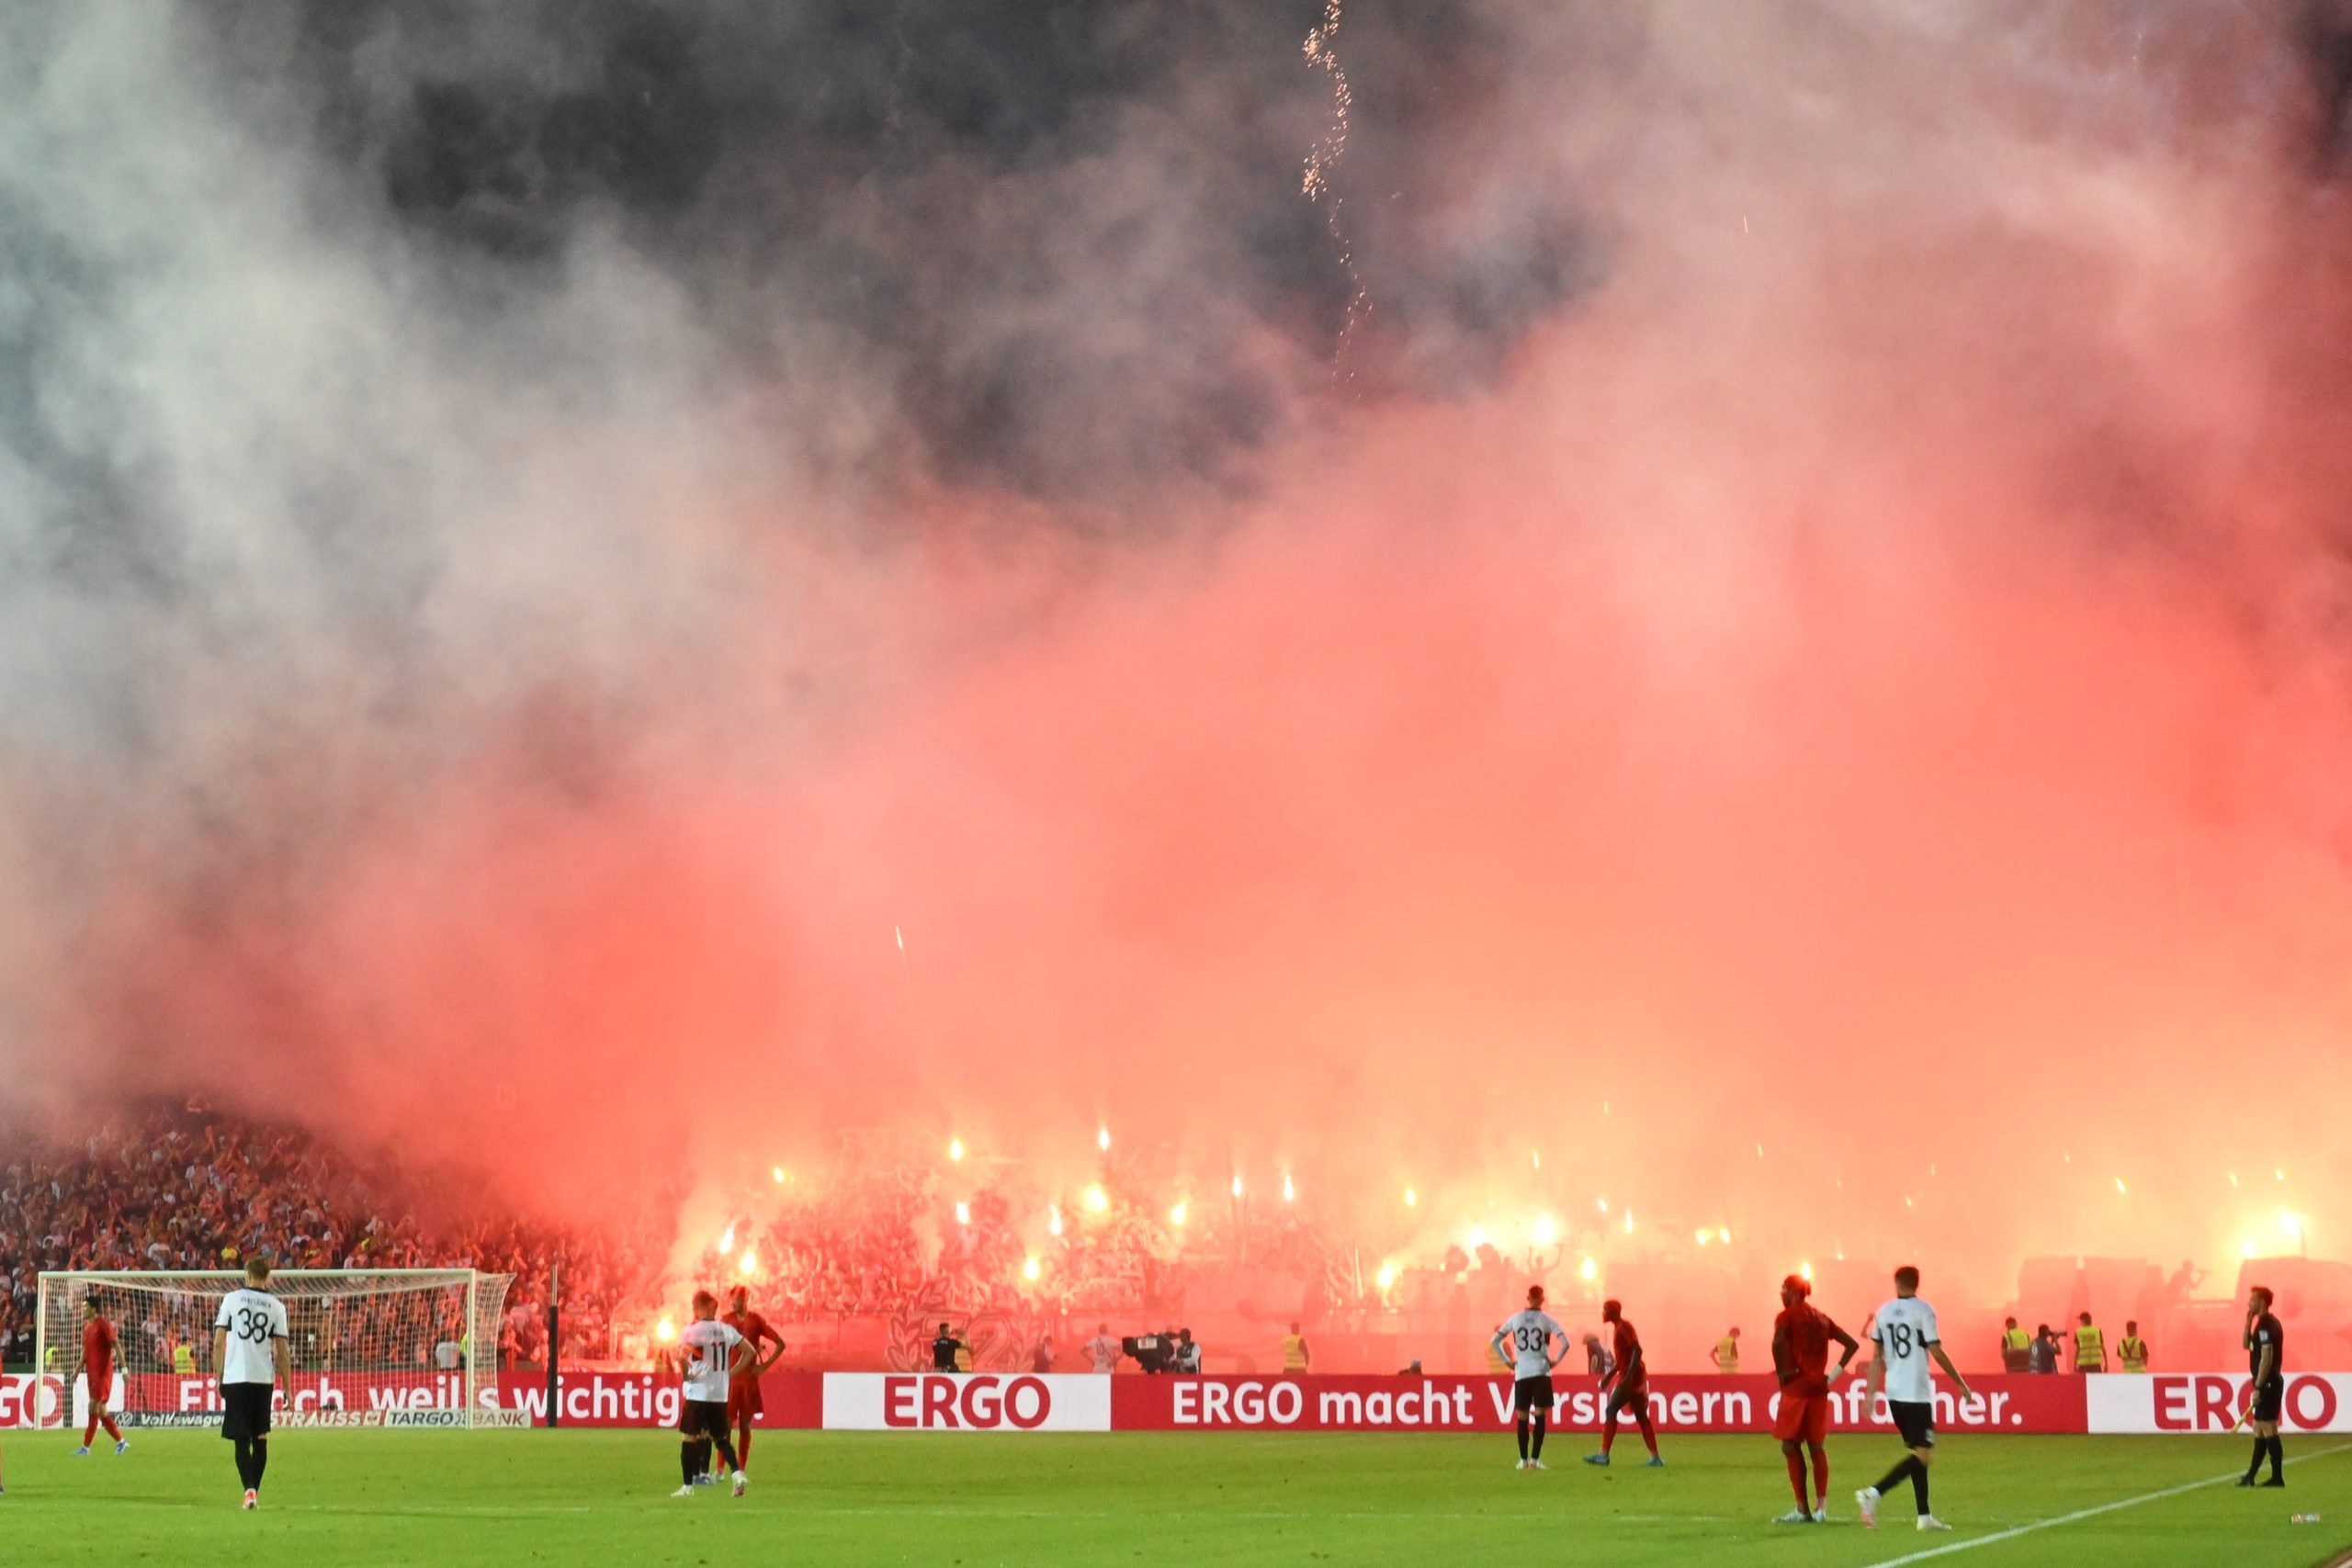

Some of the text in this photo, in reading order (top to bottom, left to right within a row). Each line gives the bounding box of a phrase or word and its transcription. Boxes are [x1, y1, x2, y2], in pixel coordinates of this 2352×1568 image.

[237, 1307, 268, 1344] 38
[1517, 1326, 1544, 1351] 33
[1886, 1323, 1912, 1359] 18
[711, 1342, 726, 1371] 11
[884, 1376, 1051, 1428] ERGO
[1173, 1382, 1303, 1425] ERGO
[1319, 1380, 1473, 1425] macht
